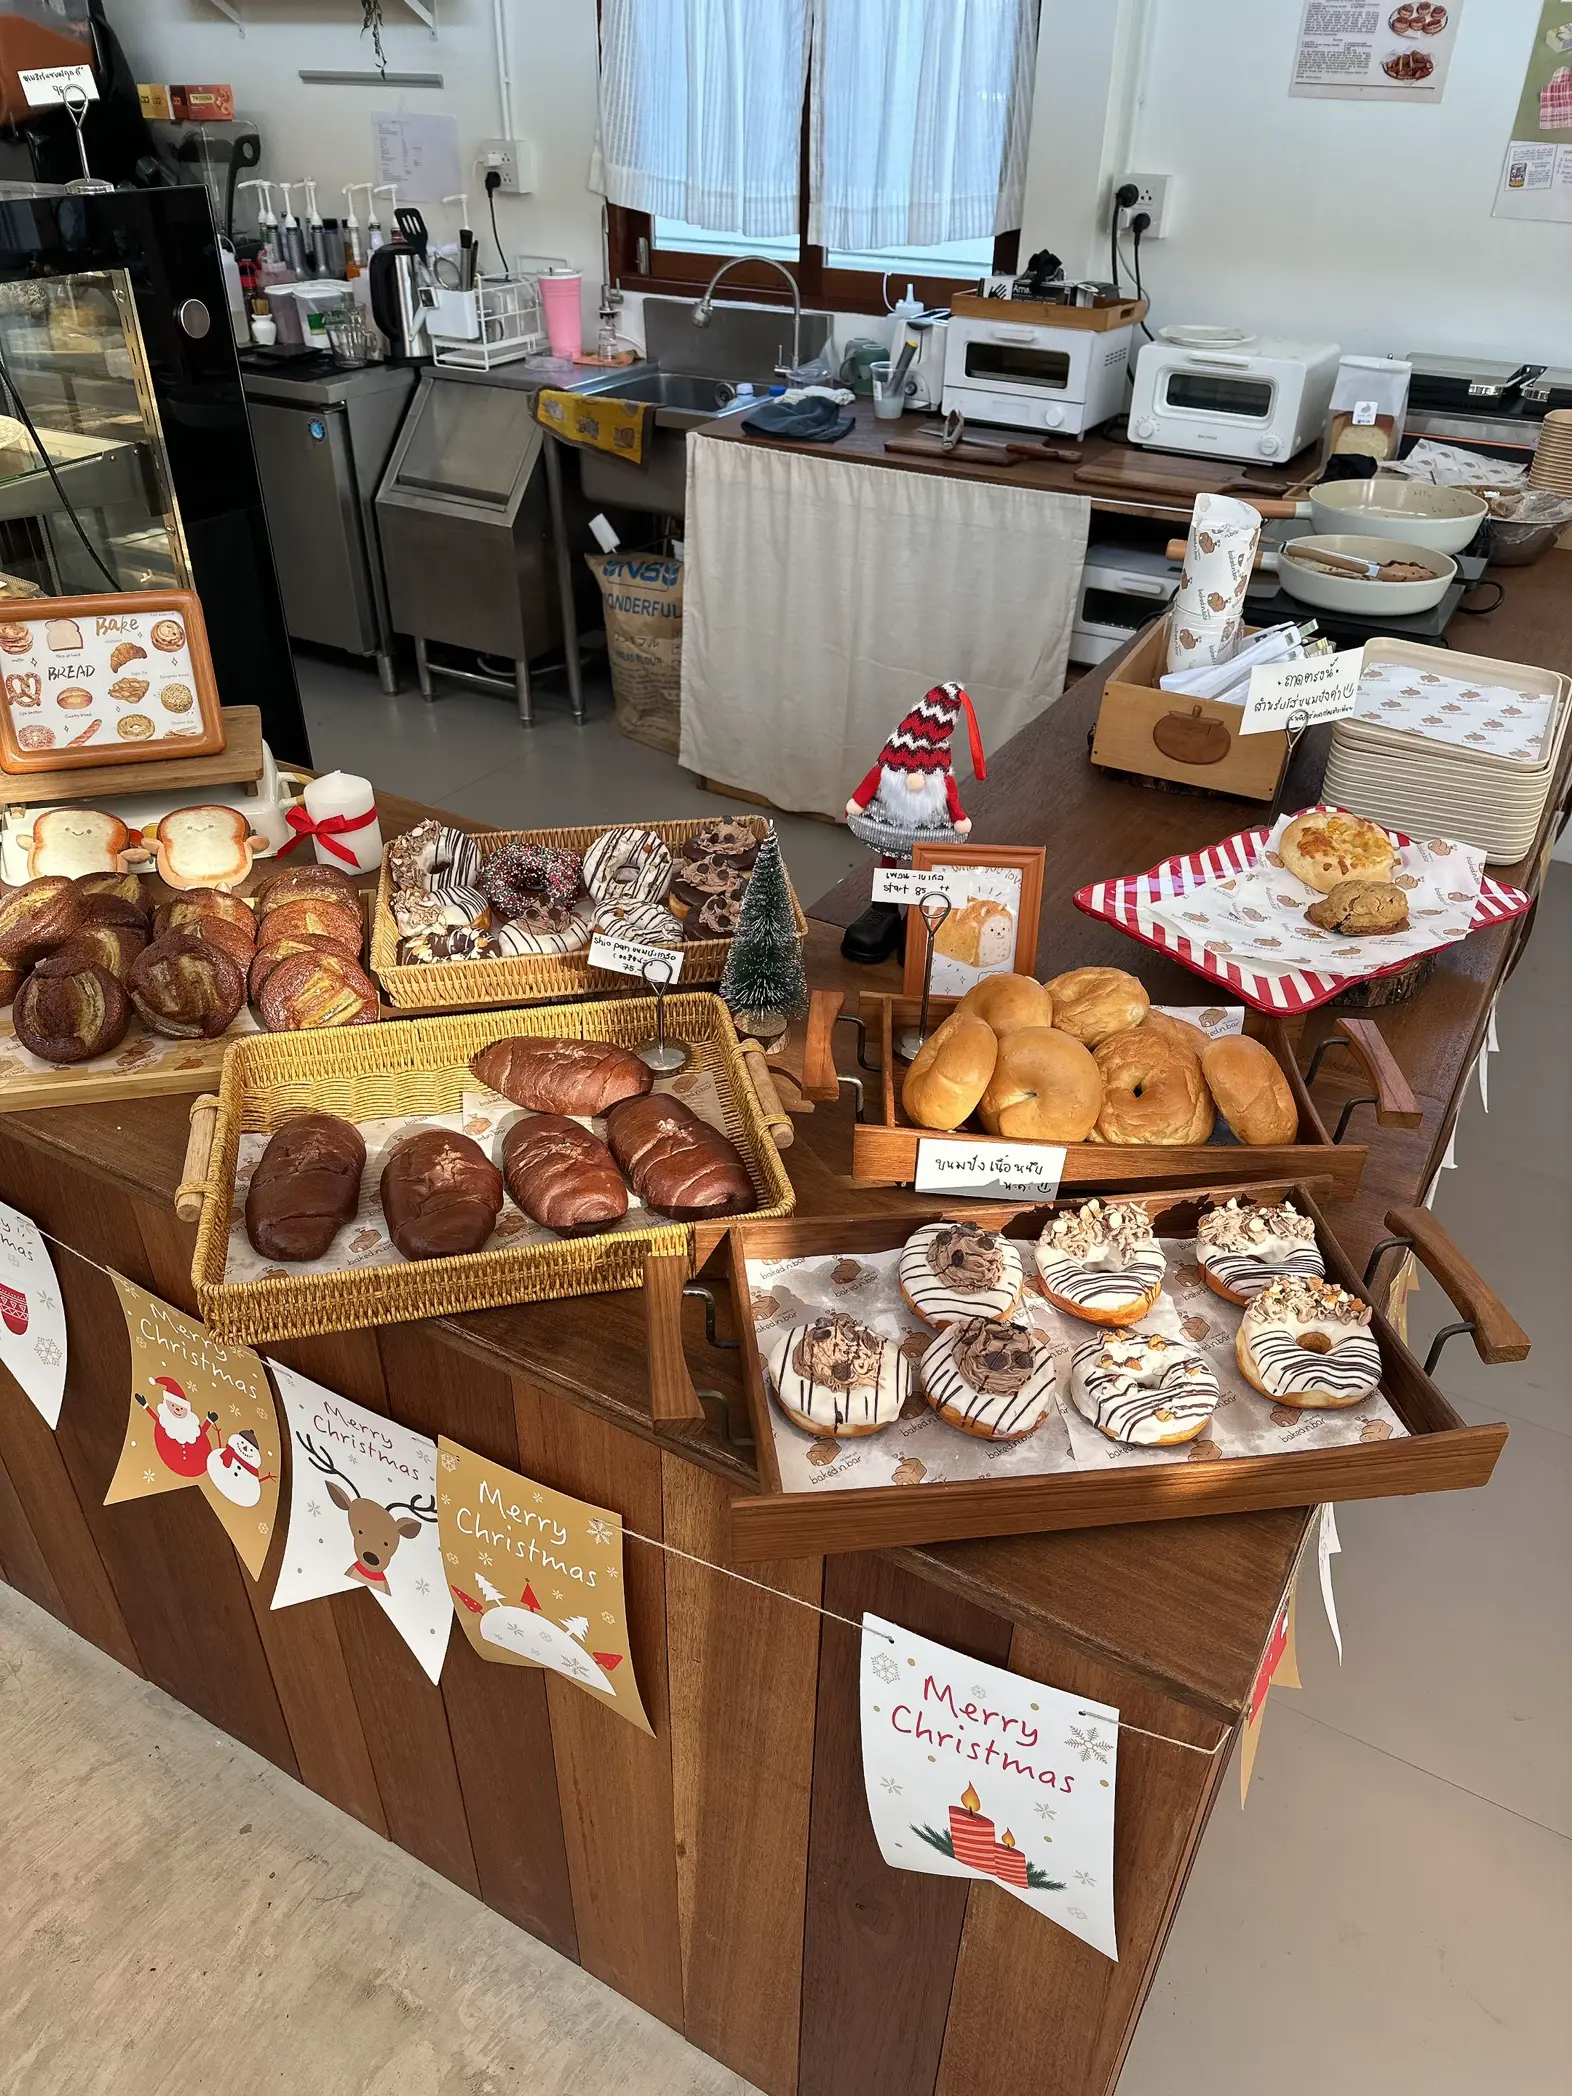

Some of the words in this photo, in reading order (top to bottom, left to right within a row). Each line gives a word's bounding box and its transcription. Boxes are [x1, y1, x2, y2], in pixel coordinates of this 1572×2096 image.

[96, 615, 140, 637] Bake
[47, 664, 96, 682] BREAD
[883, 882, 909, 895] start
[914, 887, 927, 896] 85
[593, 936, 612, 947] shio
[613, 942, 631, 951] pan
[140, 1318, 258, 1400] Christmas
[150, 1302, 228, 1362] Merry
[312, 1414, 420, 1481] Christmas
[323, 1400, 394, 1449] Merry
[479, 1479, 568, 1545] Merry
[456, 1507, 597, 1588] Christmas
[923, 1675, 1039, 1747] Merry
[891, 1704, 1075, 1794] Christmas
